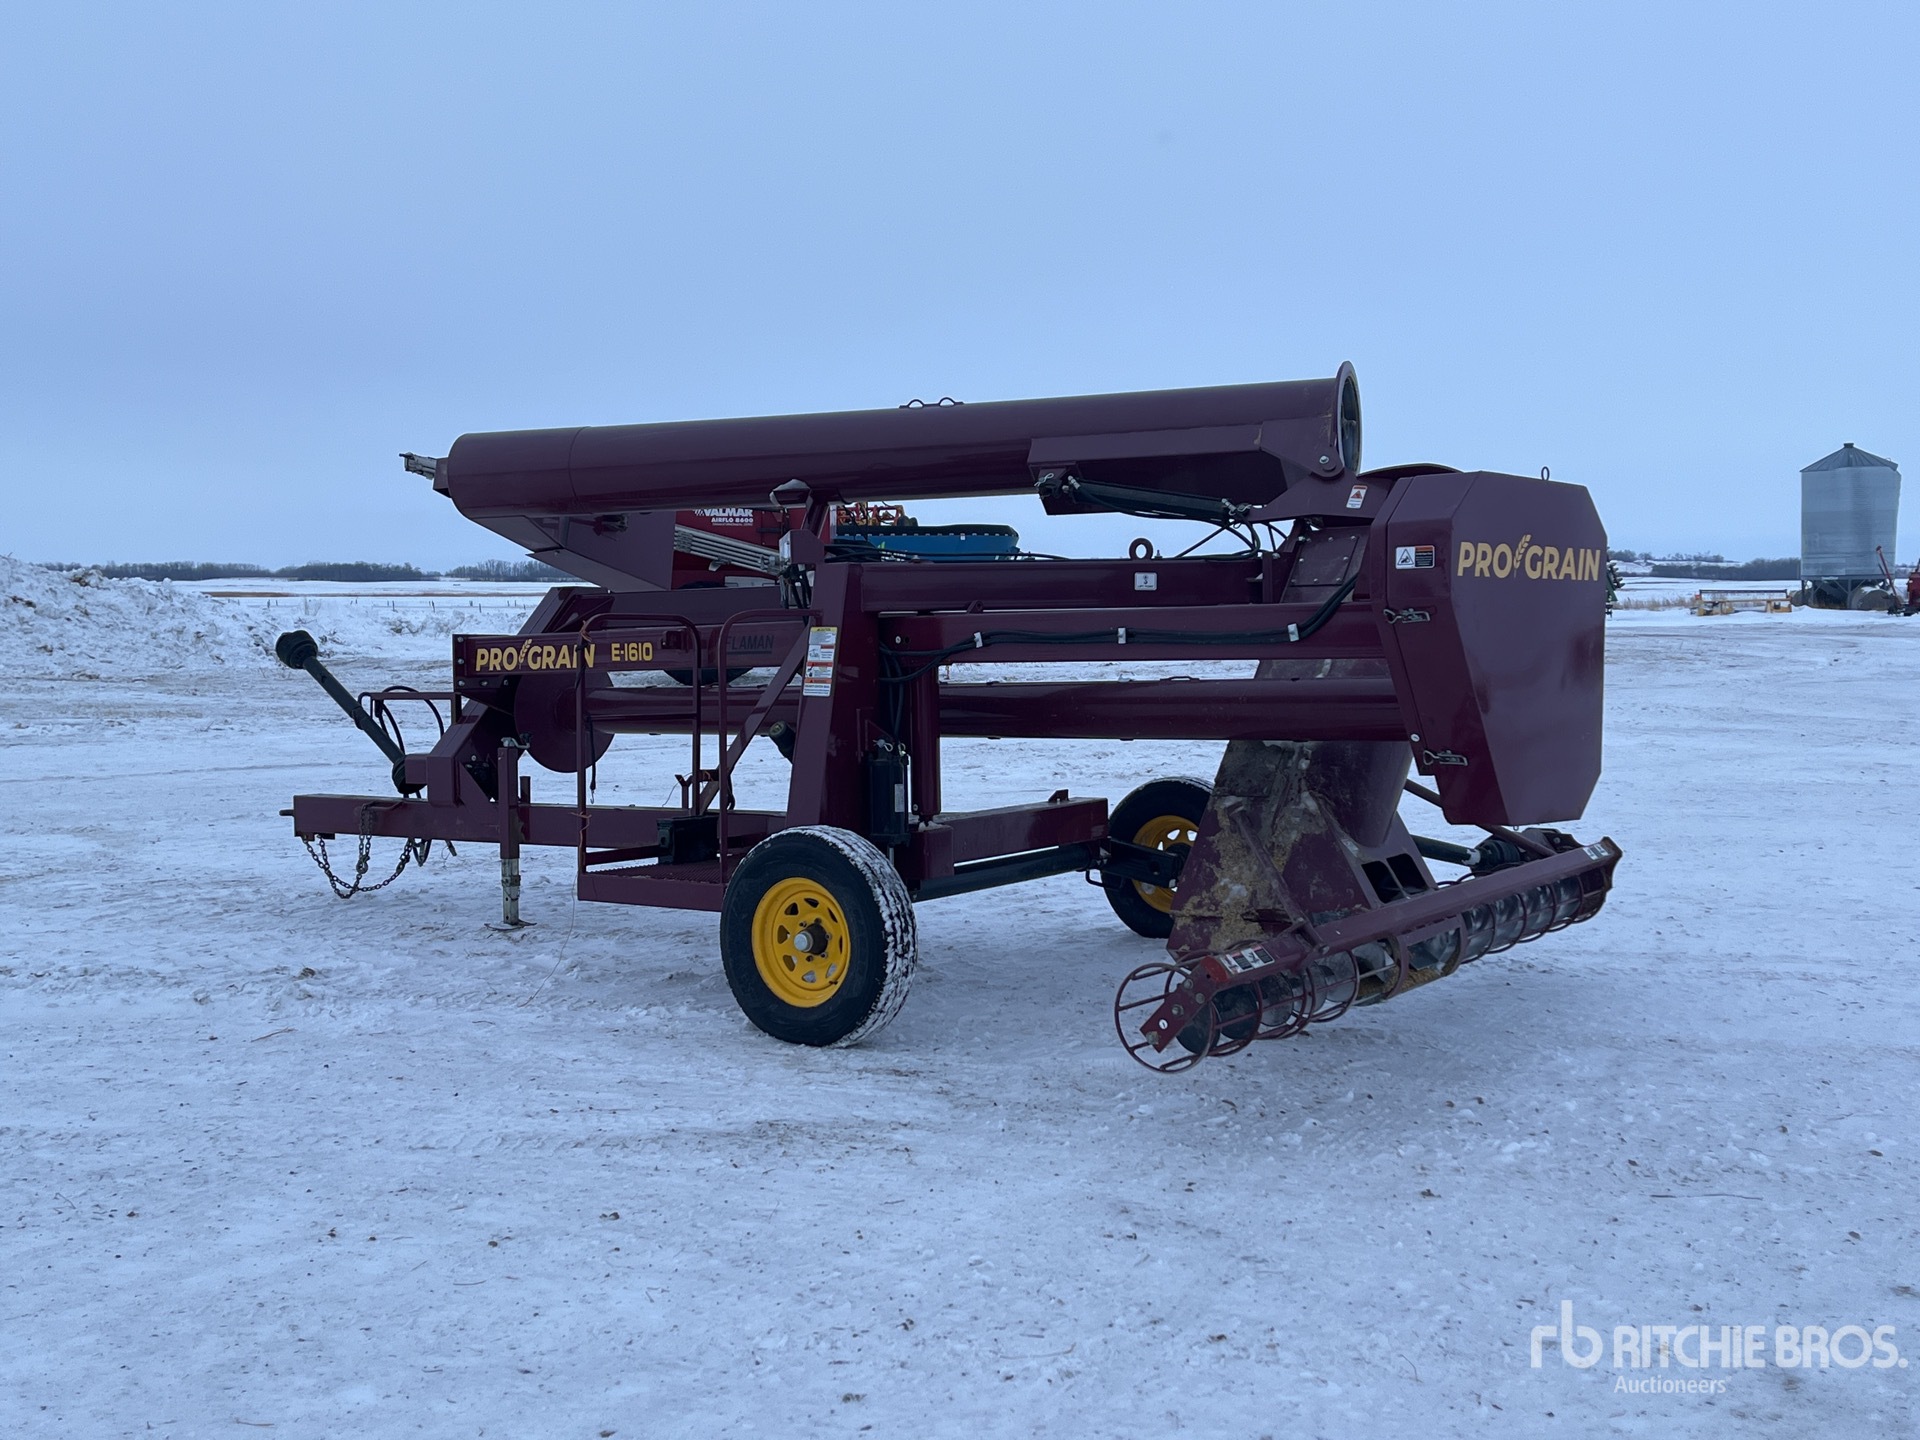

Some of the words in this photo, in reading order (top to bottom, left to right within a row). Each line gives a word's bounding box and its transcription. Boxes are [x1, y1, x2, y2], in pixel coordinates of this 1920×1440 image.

[703, 508, 753, 517] VALMAR
[1457, 541, 1514, 579] PRO
[1525, 545, 1600, 581] GRAIN
[475, 646, 518, 672] PRO
[611, 642, 653, 662] E-1610
